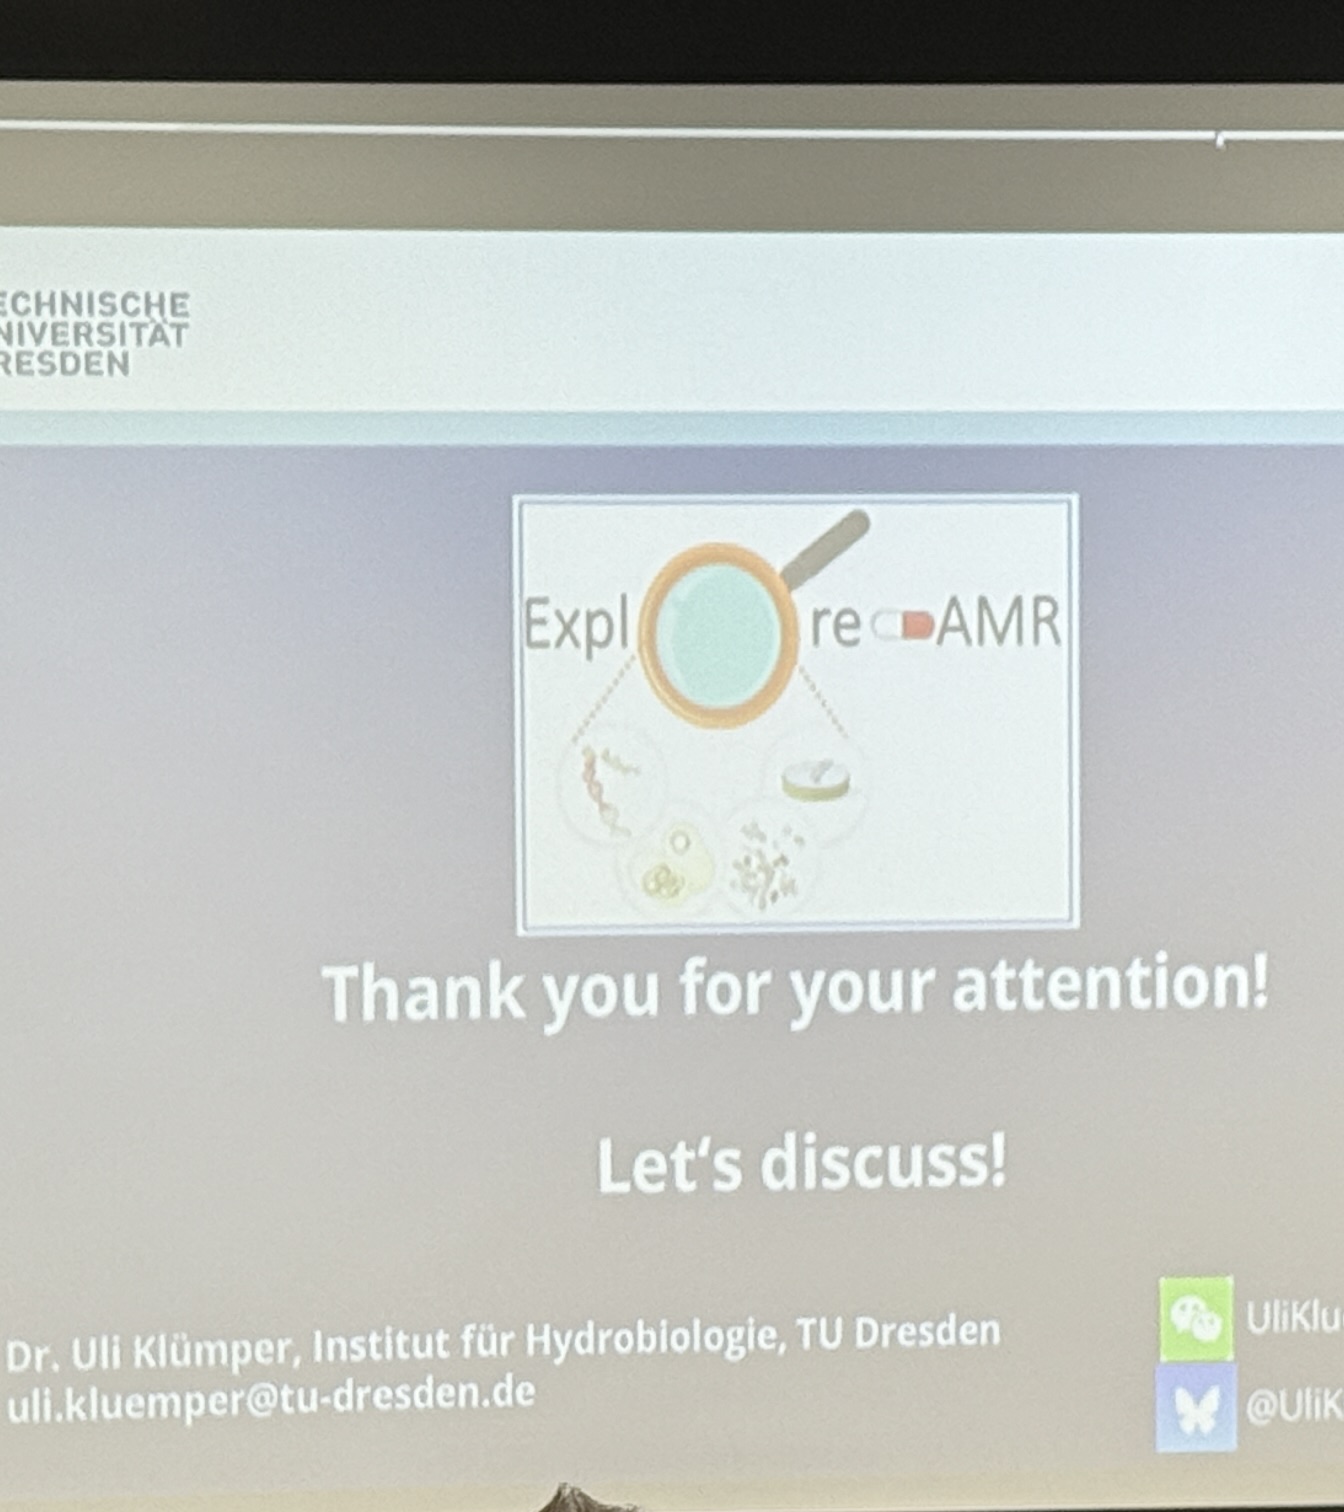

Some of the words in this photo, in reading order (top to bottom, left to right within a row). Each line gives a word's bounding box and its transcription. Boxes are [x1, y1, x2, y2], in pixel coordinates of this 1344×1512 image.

[936, 594, 1062, 647] AMR
[321, 959, 526, 1023] Thank
[542, 973, 659, 1037] you
[679, 955, 772, 1016] for
[789, 967, 936, 1032] your
[953, 949, 1268, 1012] attention!
[761, 1131, 1005, 1191] discuss!
[7, 1340, 60, 1373] Dr.
[72, 1334, 121, 1371] Uli
[134, 1332, 301, 1376] Klümper,
[314, 1325, 450, 1363] Institut
[460, 1323, 516, 1359] für
[526, 1316, 787, 1366] Hydrobiologie,
[796, 1316, 843, 1350] TU
[856, 1312, 1001, 1349] Dresden
[8, 1369, 536, 1427] uli.kluemper@tu-dresden.de
